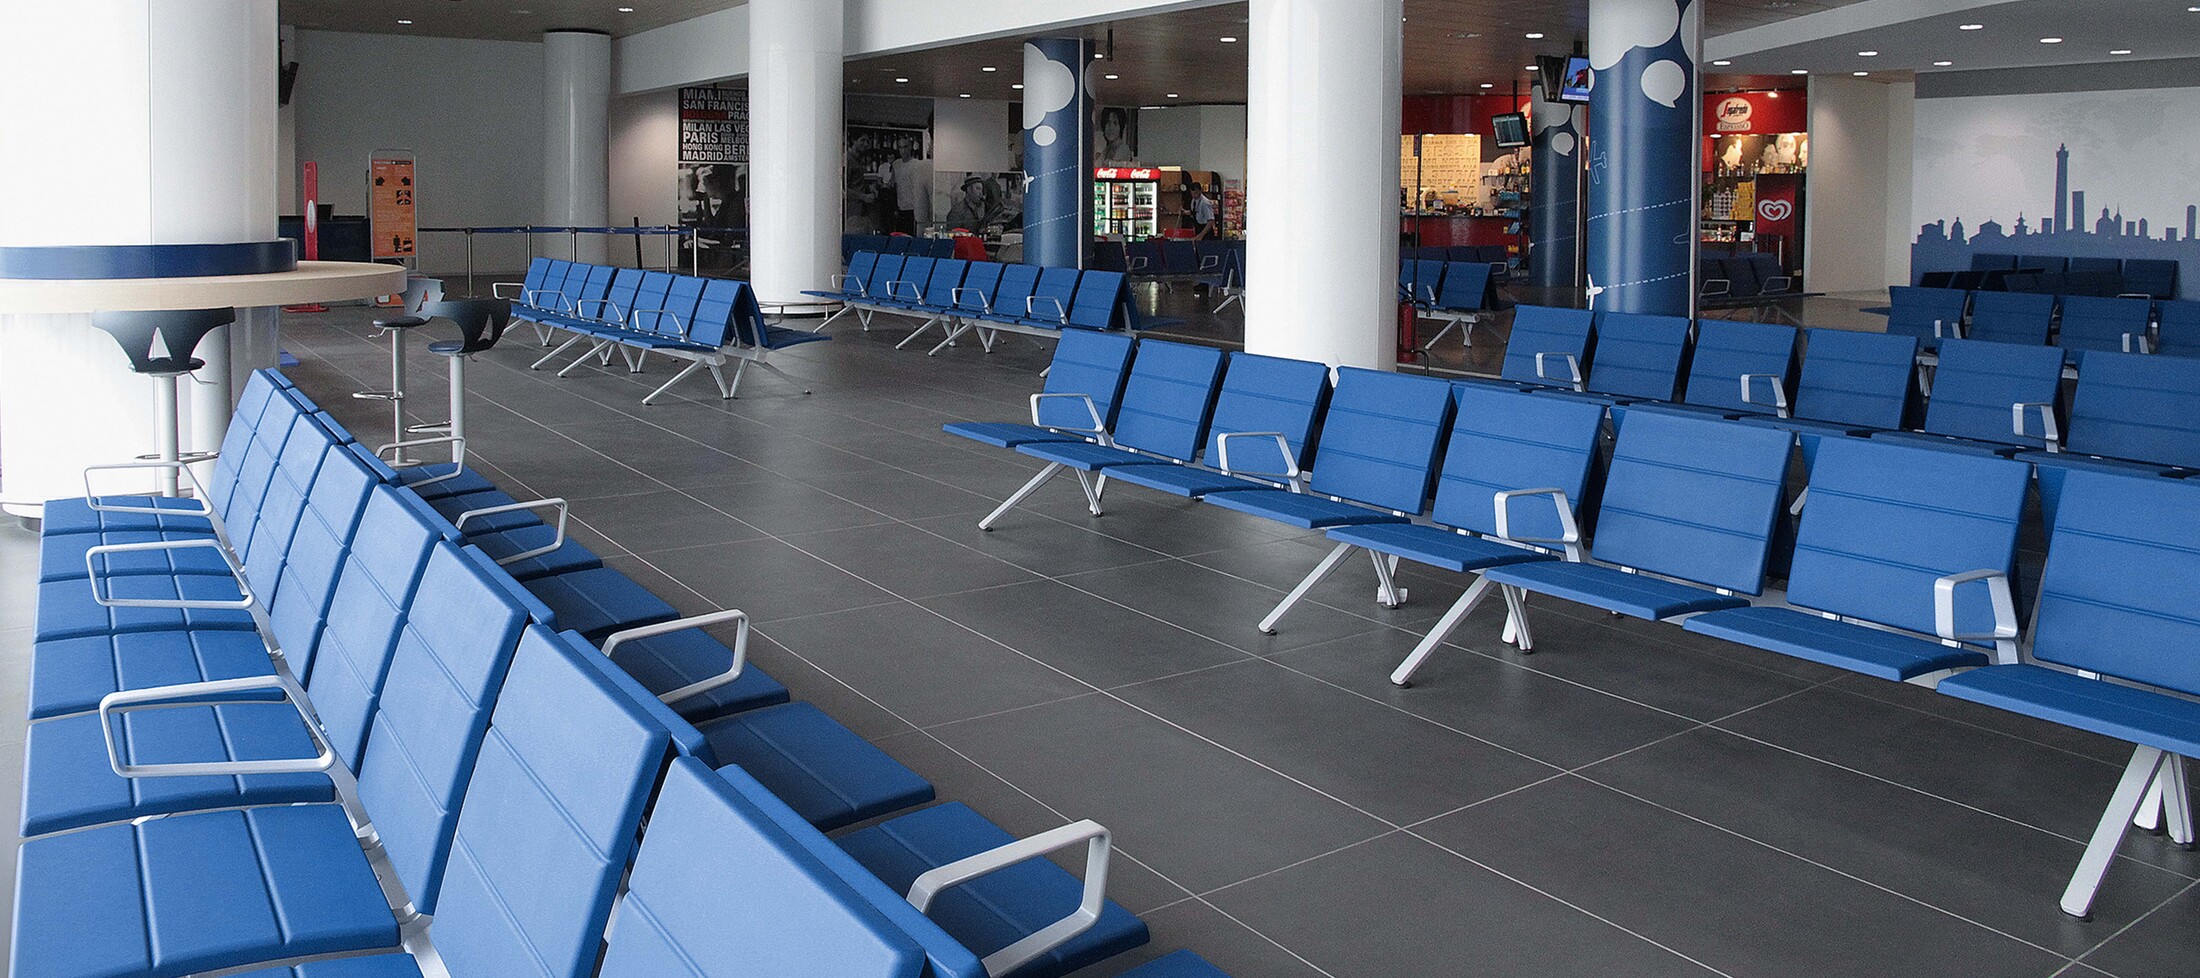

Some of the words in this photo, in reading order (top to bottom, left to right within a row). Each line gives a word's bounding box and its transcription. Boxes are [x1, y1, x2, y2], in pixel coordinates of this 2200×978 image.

[683, 100, 705, 110] SAN
[682, 122, 713, 132] MILAN
[714, 123, 732, 133] LAS
[683, 132, 719, 143] PARIS
[682, 143, 703, 151] HONG
[704, 143, 723, 151] KONG
[682, 151, 723, 161] MADRID
